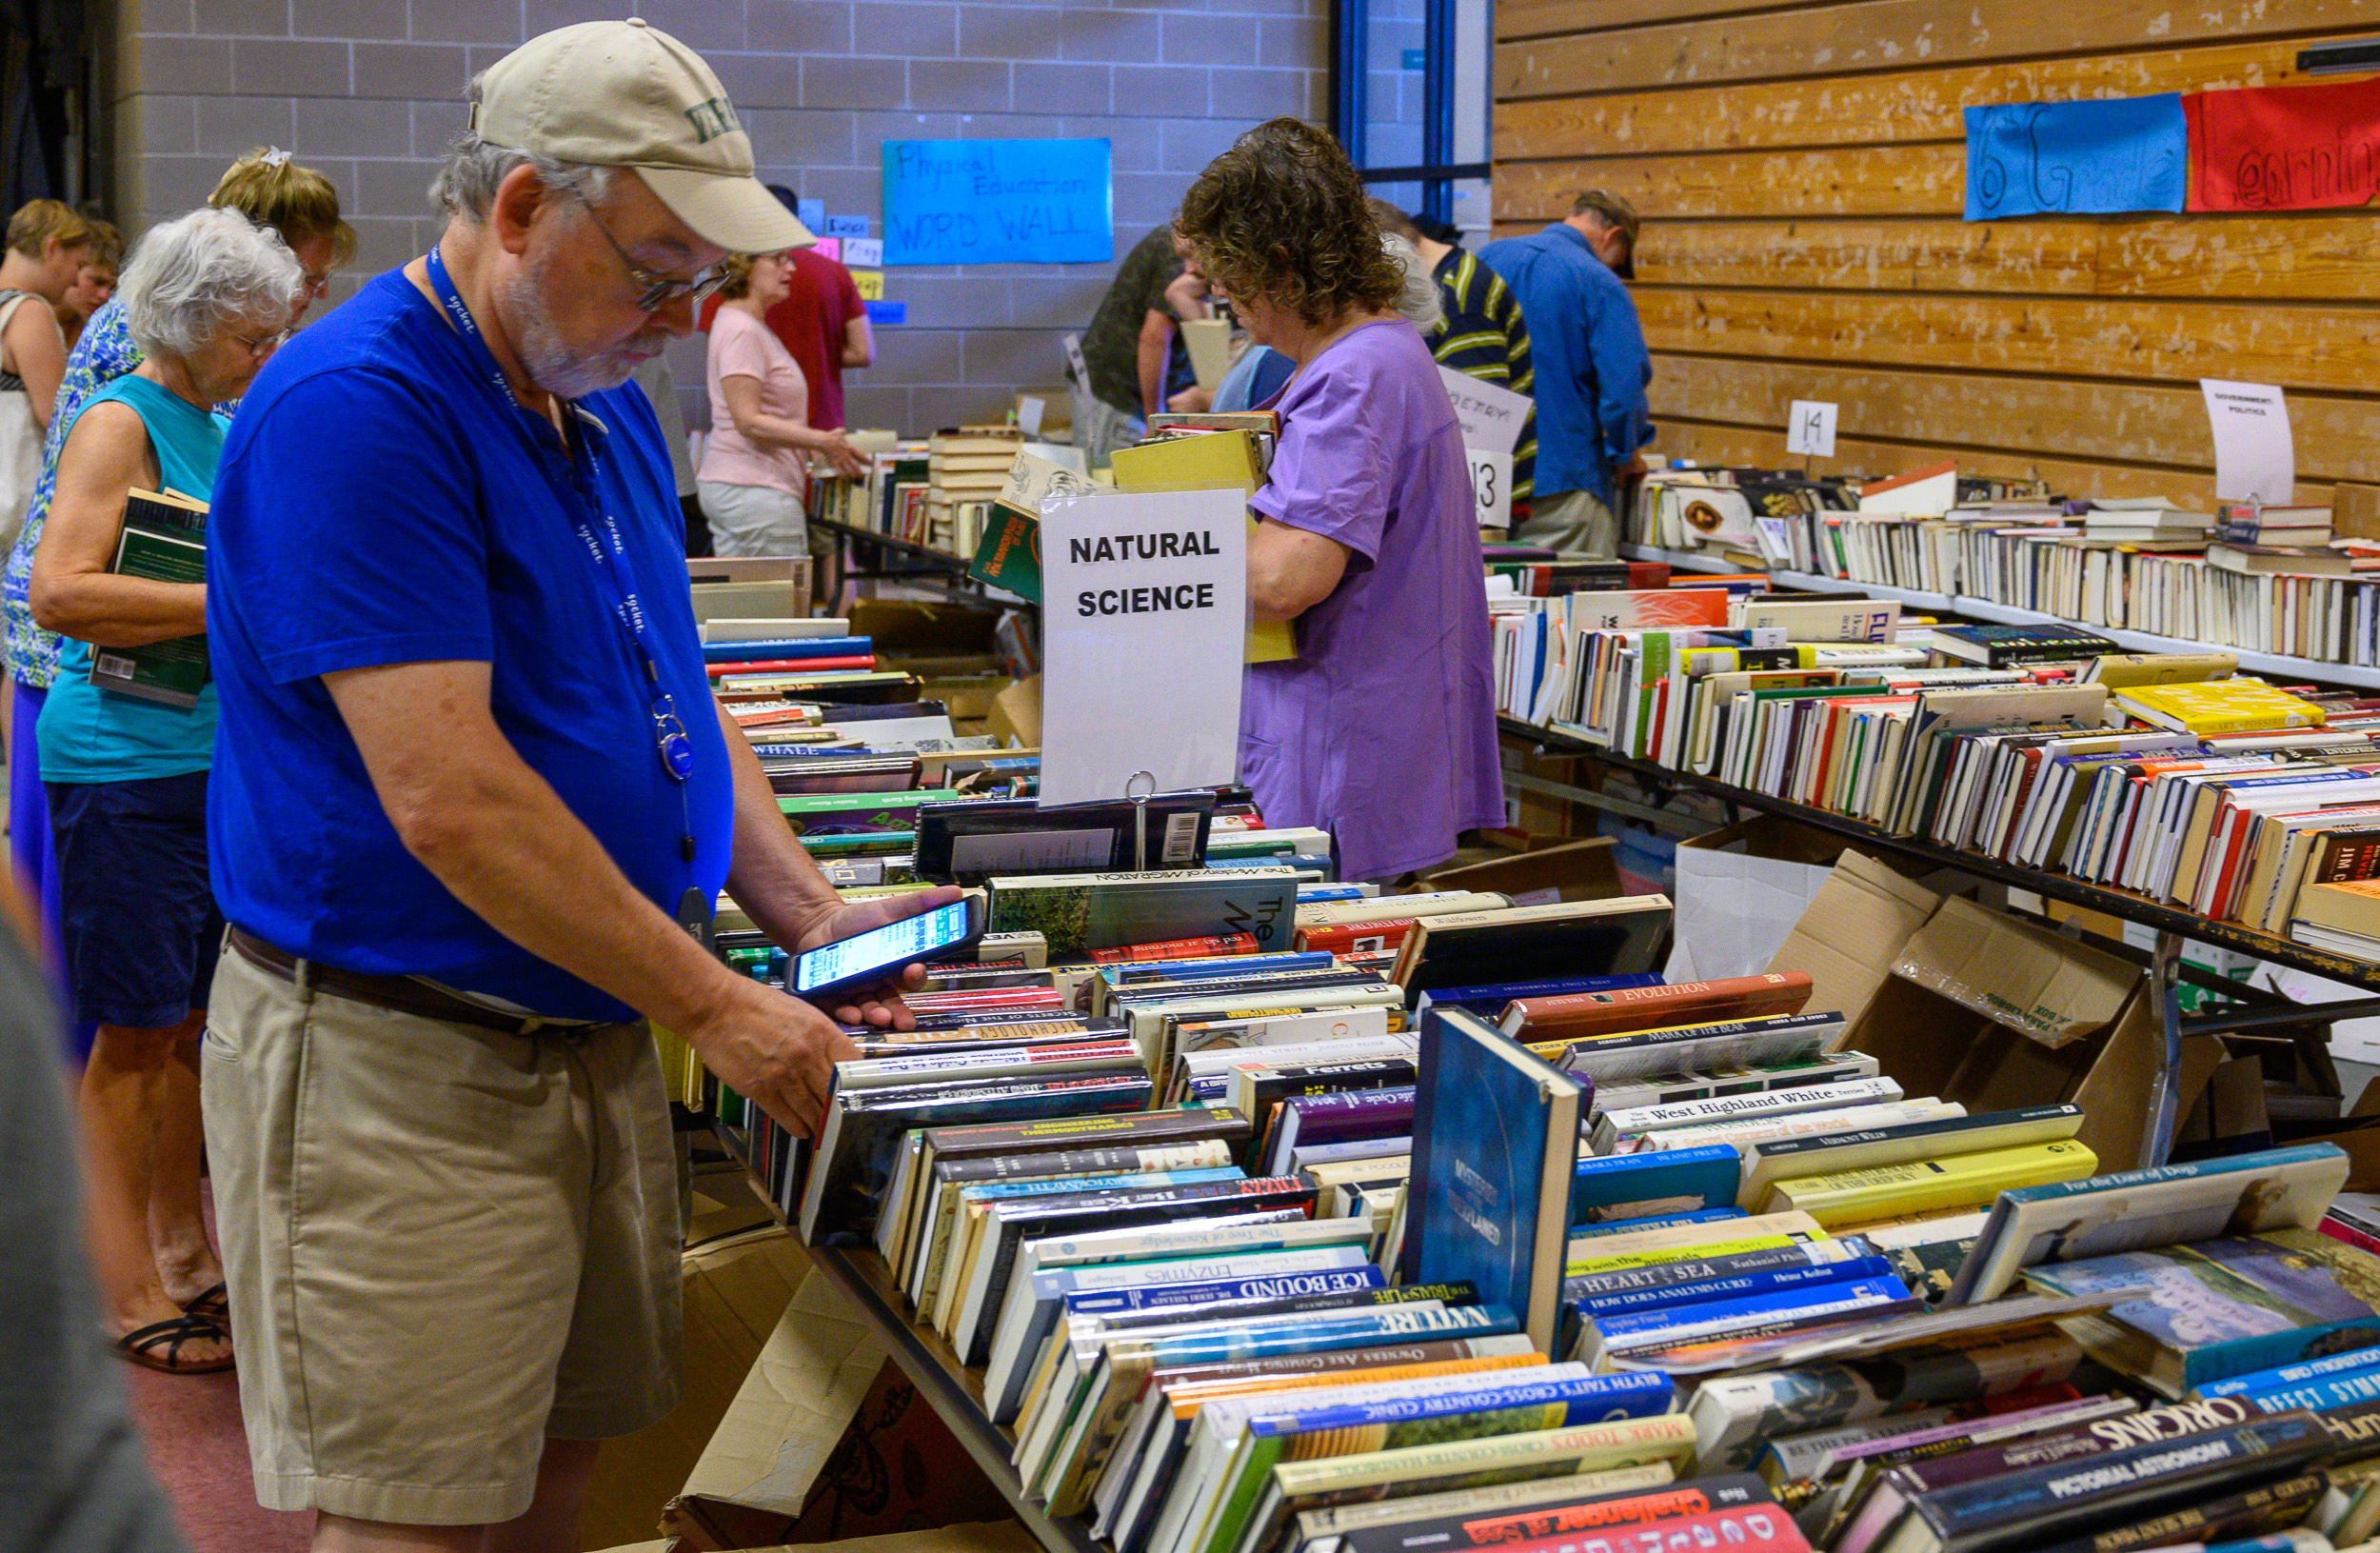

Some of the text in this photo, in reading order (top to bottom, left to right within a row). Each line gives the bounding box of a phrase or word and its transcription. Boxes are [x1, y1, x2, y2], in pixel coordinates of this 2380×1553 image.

[2198, 94, 2380, 209] Learnin
[896, 144, 996, 190] Physical
[974, 173, 1086, 195] Education
[893, 211, 978, 251] WORD
[998, 203, 1095, 242] WALL
[1451, 390, 1511, 421] OETRY
[1803, 409, 1822, 444] 14
[1472, 462, 1496, 508] 13
[1069, 530, 1220, 563] NATURAL
[1078, 583, 1214, 617] SCIENCE
[753, 745, 819, 755] WHALE
[1095, 870, 1183, 881] MIGRATION
[1256, 896, 1283, 941] The
[1132, 942, 1183, 952] morning
[1202, 937, 1221, 946] sky
[1223, 935, 1243, 945] red
[1621, 982, 1711, 1000] EVOLUTION
[937, 1016, 977, 1025] NIGHT
[1031, 1009, 1078, 1019] SECRETS
[980, 1022, 1078, 1039] TECHNOLOGY
[1647, 1030, 1682, 1042] MARK
[1683, 1028, 1698, 1037] OF
[1699, 1025, 1719, 1035] THE
[1720, 1022, 1748, 1034] BEAR
[1305, 1060, 1387, 1075] Ferrets
[1365, 1093, 1397, 1104] Cycle
[1651, 1086, 1865, 1121] West Highland White Terrier
[1021, 1122, 1135, 1136] THERMODYNAMICS
[1033, 1118, 1116, 1130] ENGINEERING
[1730, 1127, 1776, 1142] Corners
[1812, 1117, 1854, 1131] World
[1693, 1148, 1722, 1159] PRESS
[1027, 1180, 1082, 1192] MYTH
[1845, 1179, 1867, 1189] THE
[1868, 1175, 1893, 1187] DEEP
[1894, 1172, 1917, 1184] SKY
[2063, 1163, 2198, 1193] For the Love of Dogs
[1136, 1190, 1178, 1202] BART
[1140, 1227, 1280, 1247] The Tree of Knowledge
[1618, 1255, 1642, 1266] the
[1643, 1251, 1702, 1268] animals
[1144, 1264, 1231, 1284] Enzymes
[1333, 1271, 1371, 1290] ICE
[1584, 1268, 1655, 1294] HEART
[1677, 1264, 1716, 1281] SEA
[1240, 1276, 1330, 1299] BOUND
[1371, 1284, 1454, 1304] TRIALS LIFE
[1150, 1294, 1196, 1305] NIELSEN
[1590, 1296, 1621, 1310] HOW
[1623, 1291, 1656, 1305] DOES
[1374, 1305, 1492, 1334] NATURE
[1265, 1356, 1324, 1369] COMING
[1328, 1353, 1358, 1365] ARE
[1362, 1348, 1425, 1362] OWNERS
[1559, 1379, 1607, 1396] TAIT'S
[1611, 1372, 1662, 1389] BLYTH
[1423, 1384, 1557, 1415] CROSS-COUNTRY
[1363, 1401, 1417, 1420] CLINIC
[1626, 1421, 1684, 1442] MARK
[2089, 1397, 2247, 1451] ORIGINS
[1551, 1430, 1618, 1452] TODD'S
[2134, 1440, 2231, 1479] ASTRONOMY
